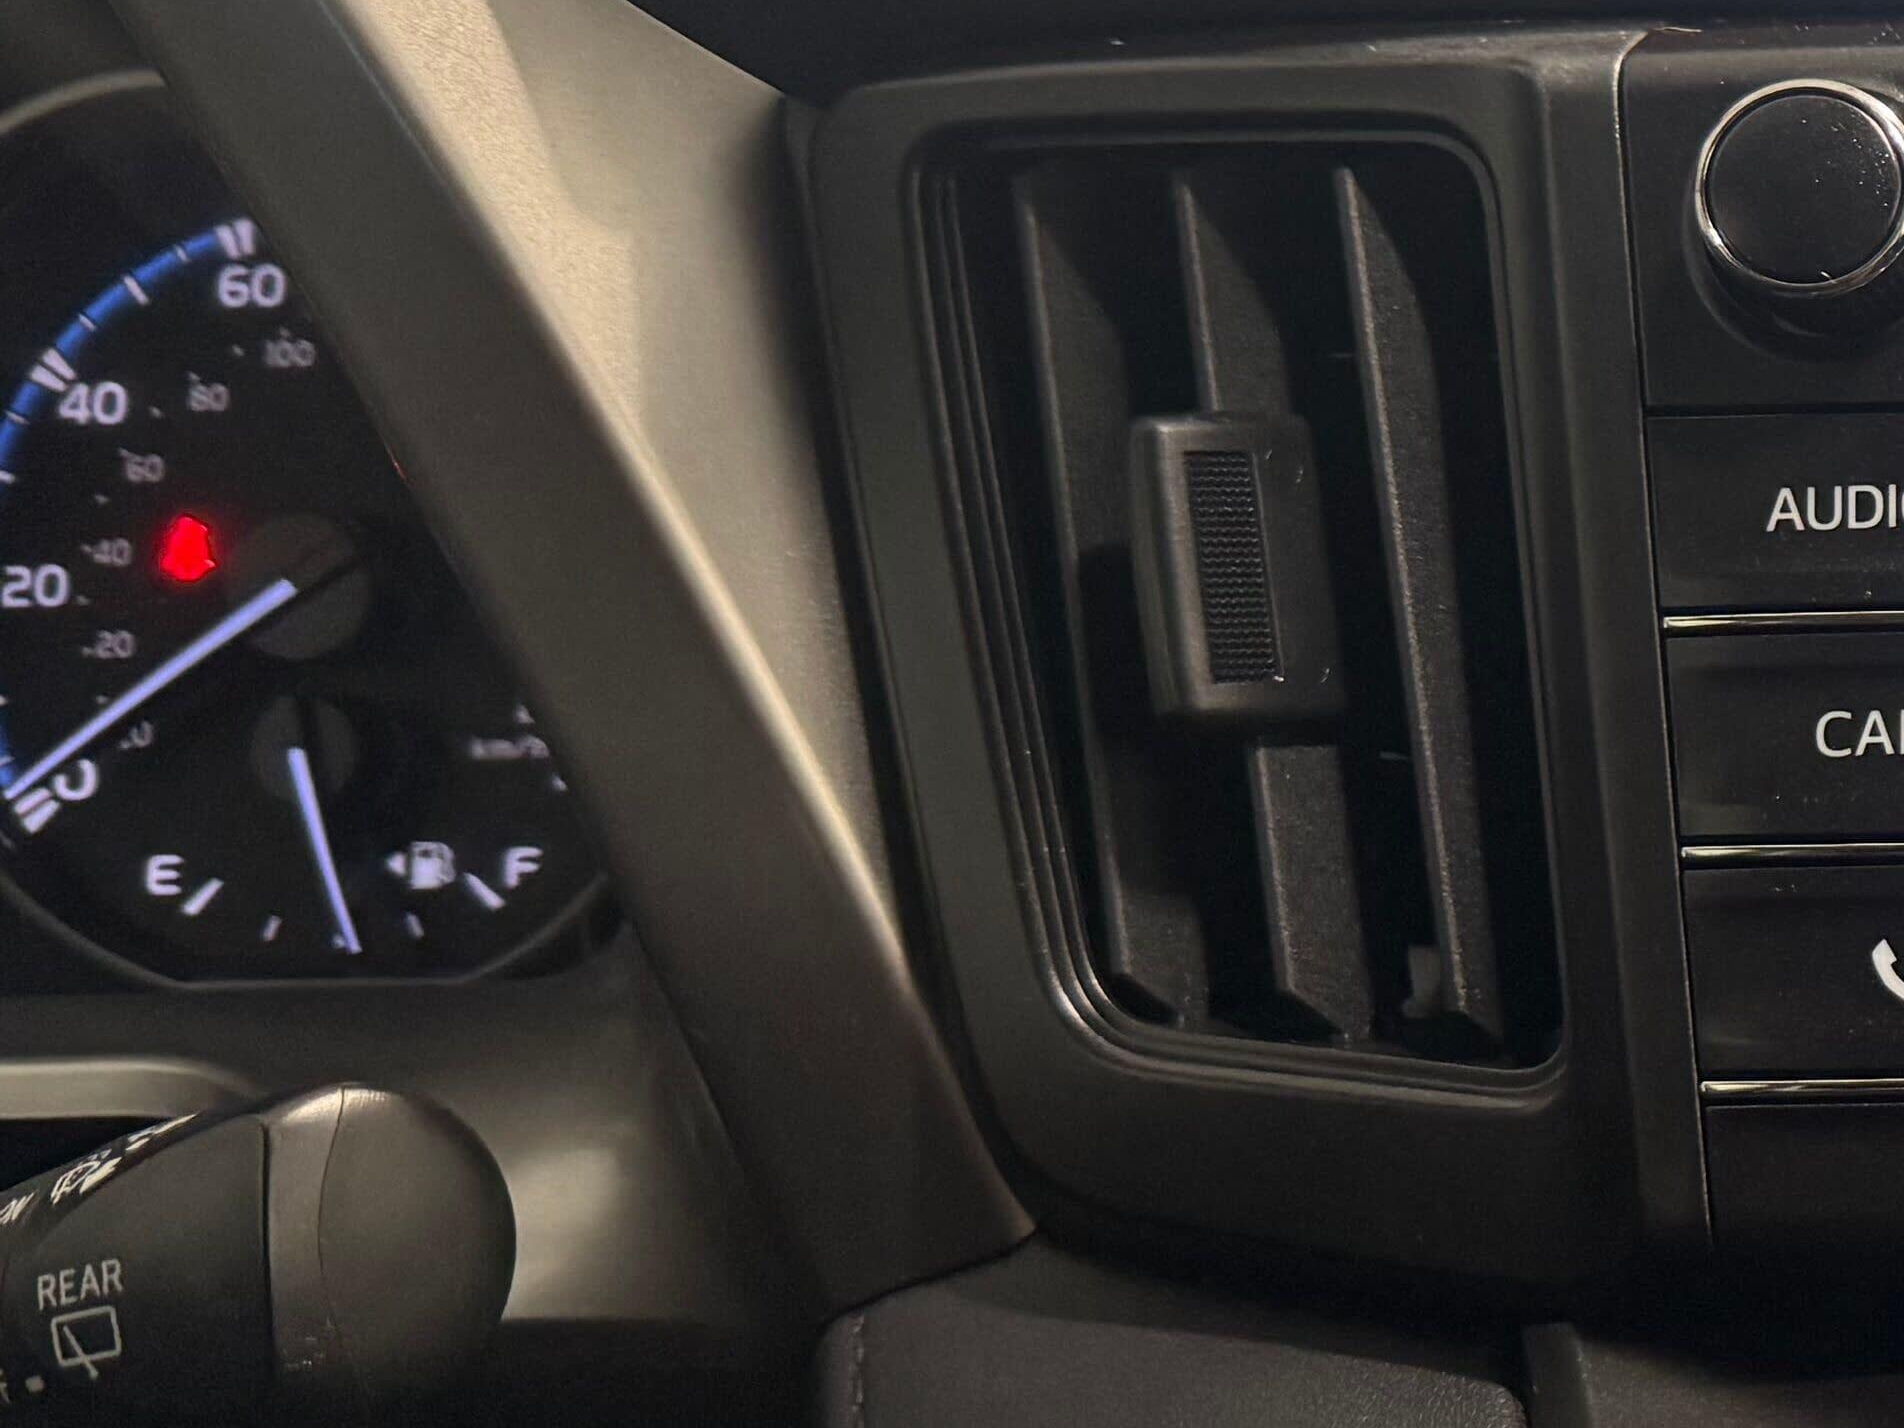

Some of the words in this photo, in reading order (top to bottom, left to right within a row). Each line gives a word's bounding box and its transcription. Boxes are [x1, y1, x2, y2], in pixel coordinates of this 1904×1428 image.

[219, 265, 284, 306] 60
[267, 341, 313, 366] 100
[58, 381, 127, 423] 40
[1, 564, 68, 608] 20
[96, 631, 132, 657] 20
[147, 855, 180, 894] E
[505, 847, 540, 886] F
[38, 1259, 122, 1311] REAR
